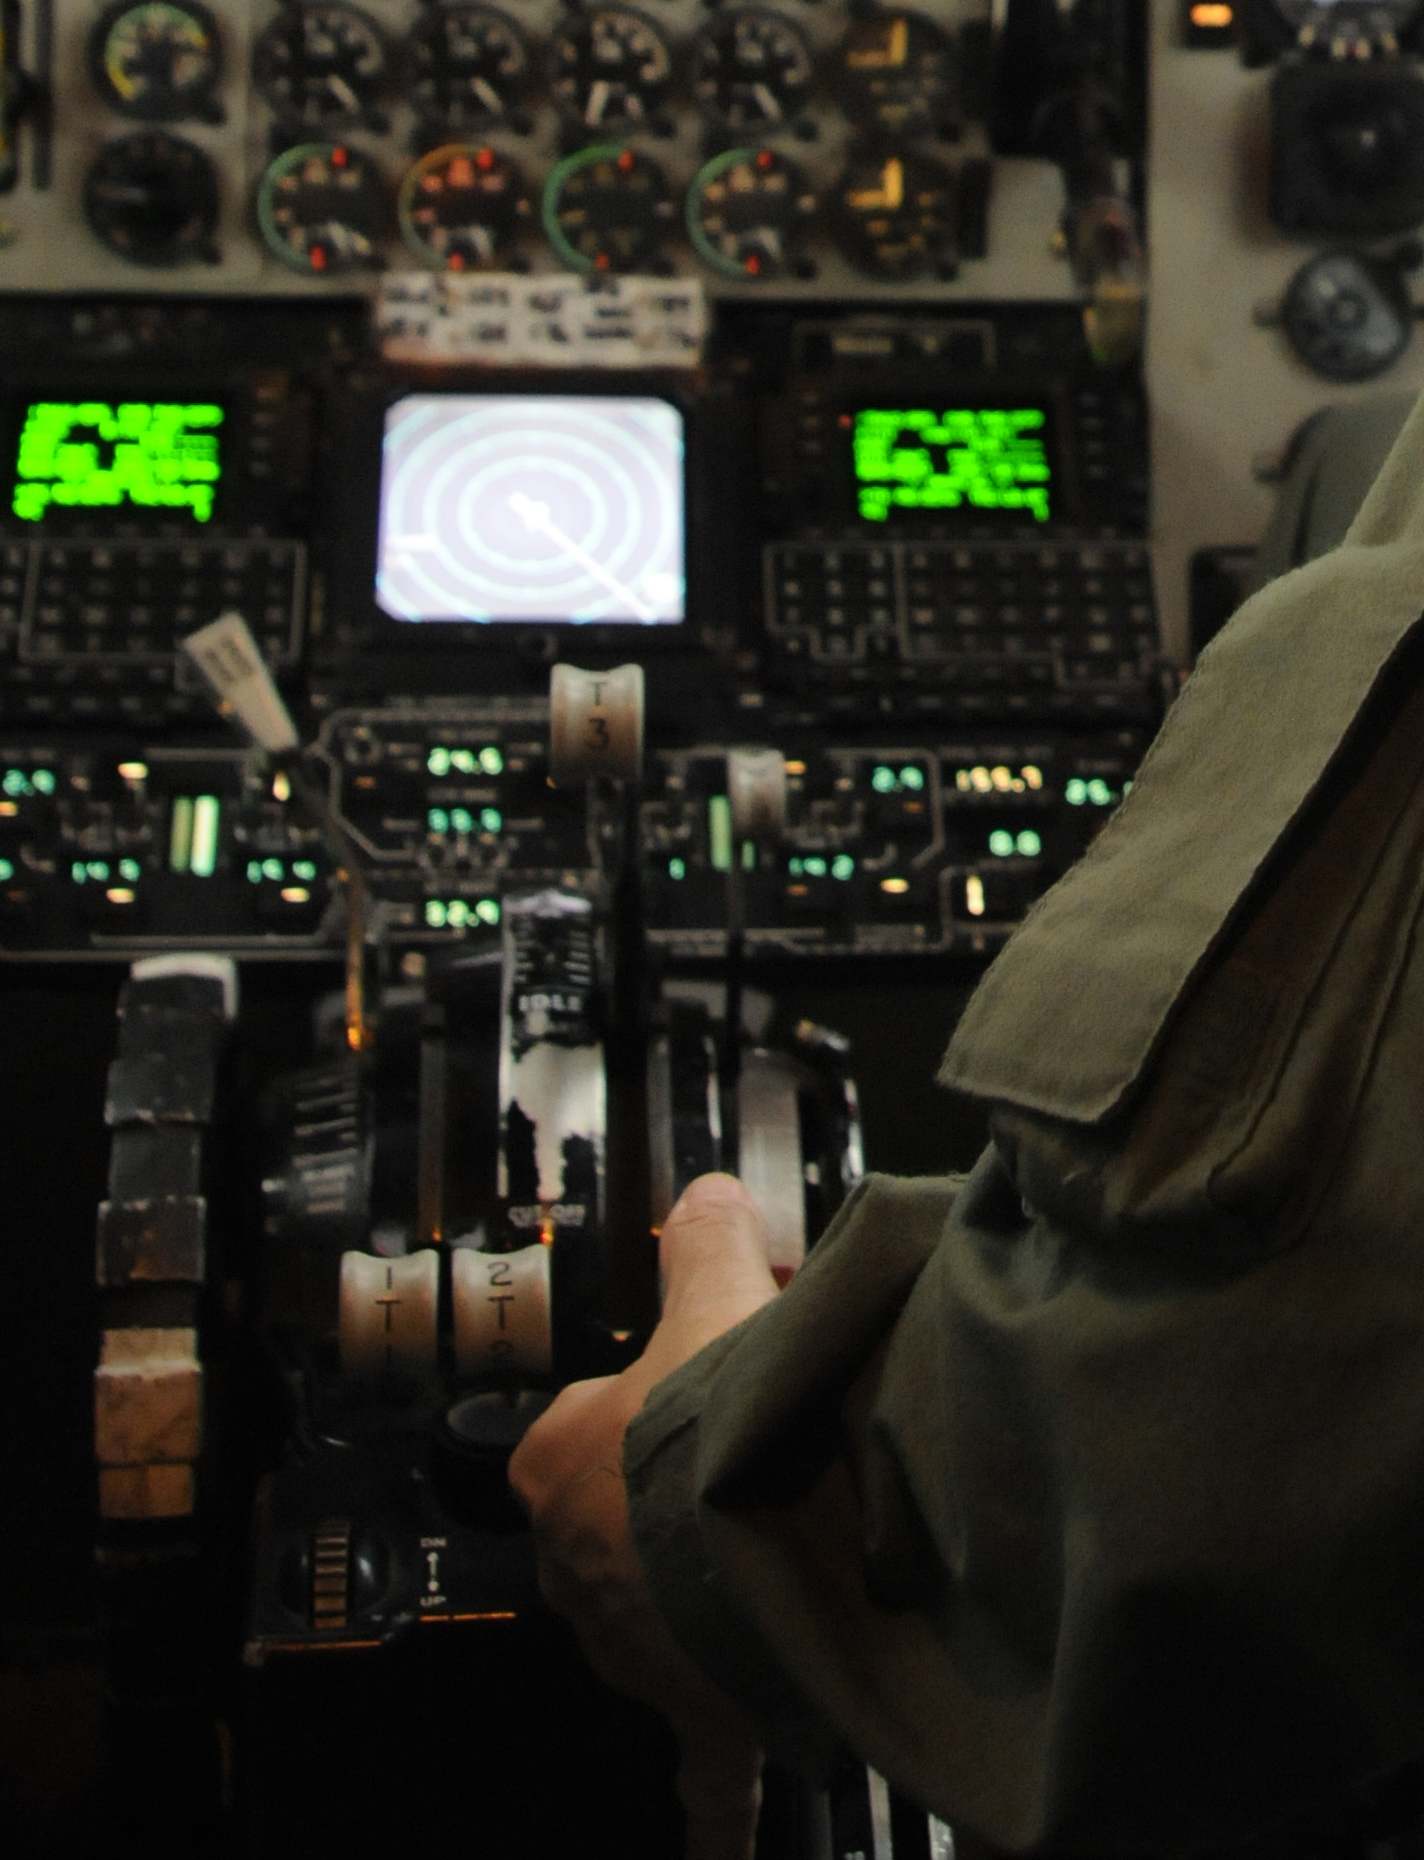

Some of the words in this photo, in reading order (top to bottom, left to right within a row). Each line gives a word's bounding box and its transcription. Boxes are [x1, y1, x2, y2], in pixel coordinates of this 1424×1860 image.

[585, 717, 610, 750] 3
[517, 992, 581, 1012] IDLE
[487, 1261, 513, 1286] 2
[375, 1298, 401, 1333] T
[488, 1295, 515, 1330] T
[419, 1595, 448, 1608] UP
